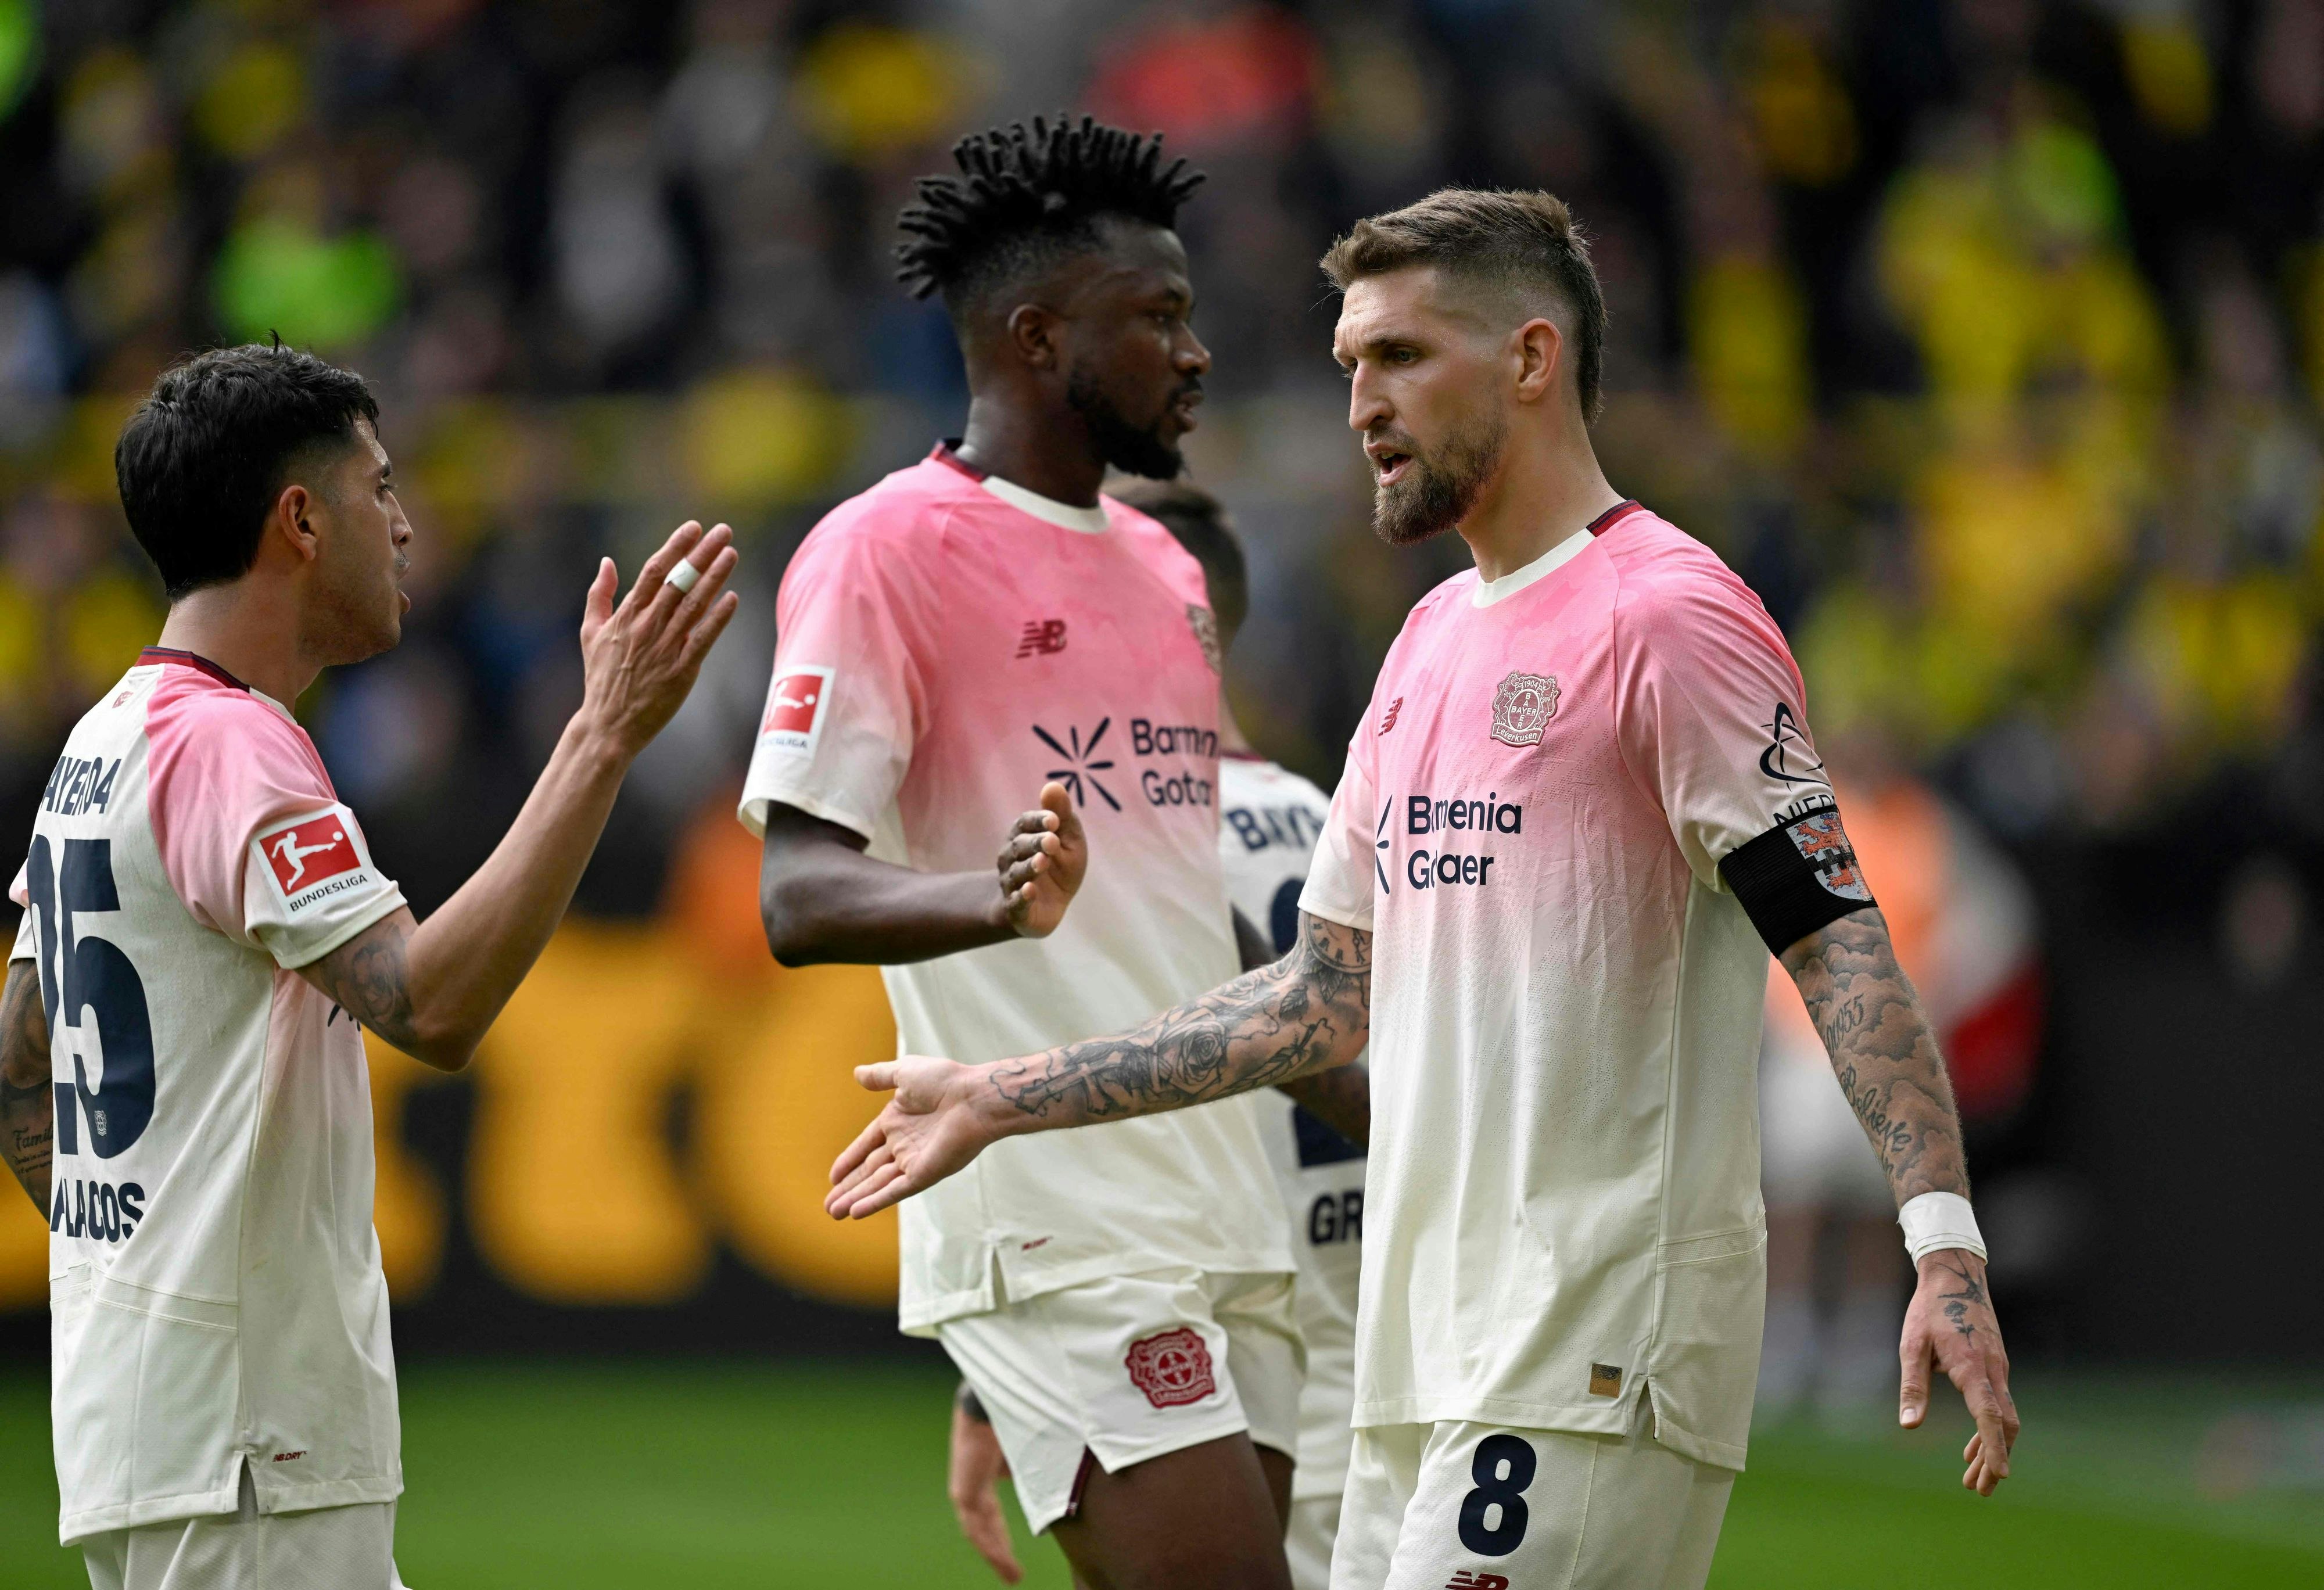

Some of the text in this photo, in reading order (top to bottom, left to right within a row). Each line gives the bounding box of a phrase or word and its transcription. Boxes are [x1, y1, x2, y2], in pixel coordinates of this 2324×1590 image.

[1524, 680, 1538, 688] 1904
[1511, 705, 1537, 715] BAYER
[1496, 726, 1537, 742] Leverkusen
[289, 874, 368, 912] BUNDESLIGA
[1458, 1434, 1537, 1556] 8
